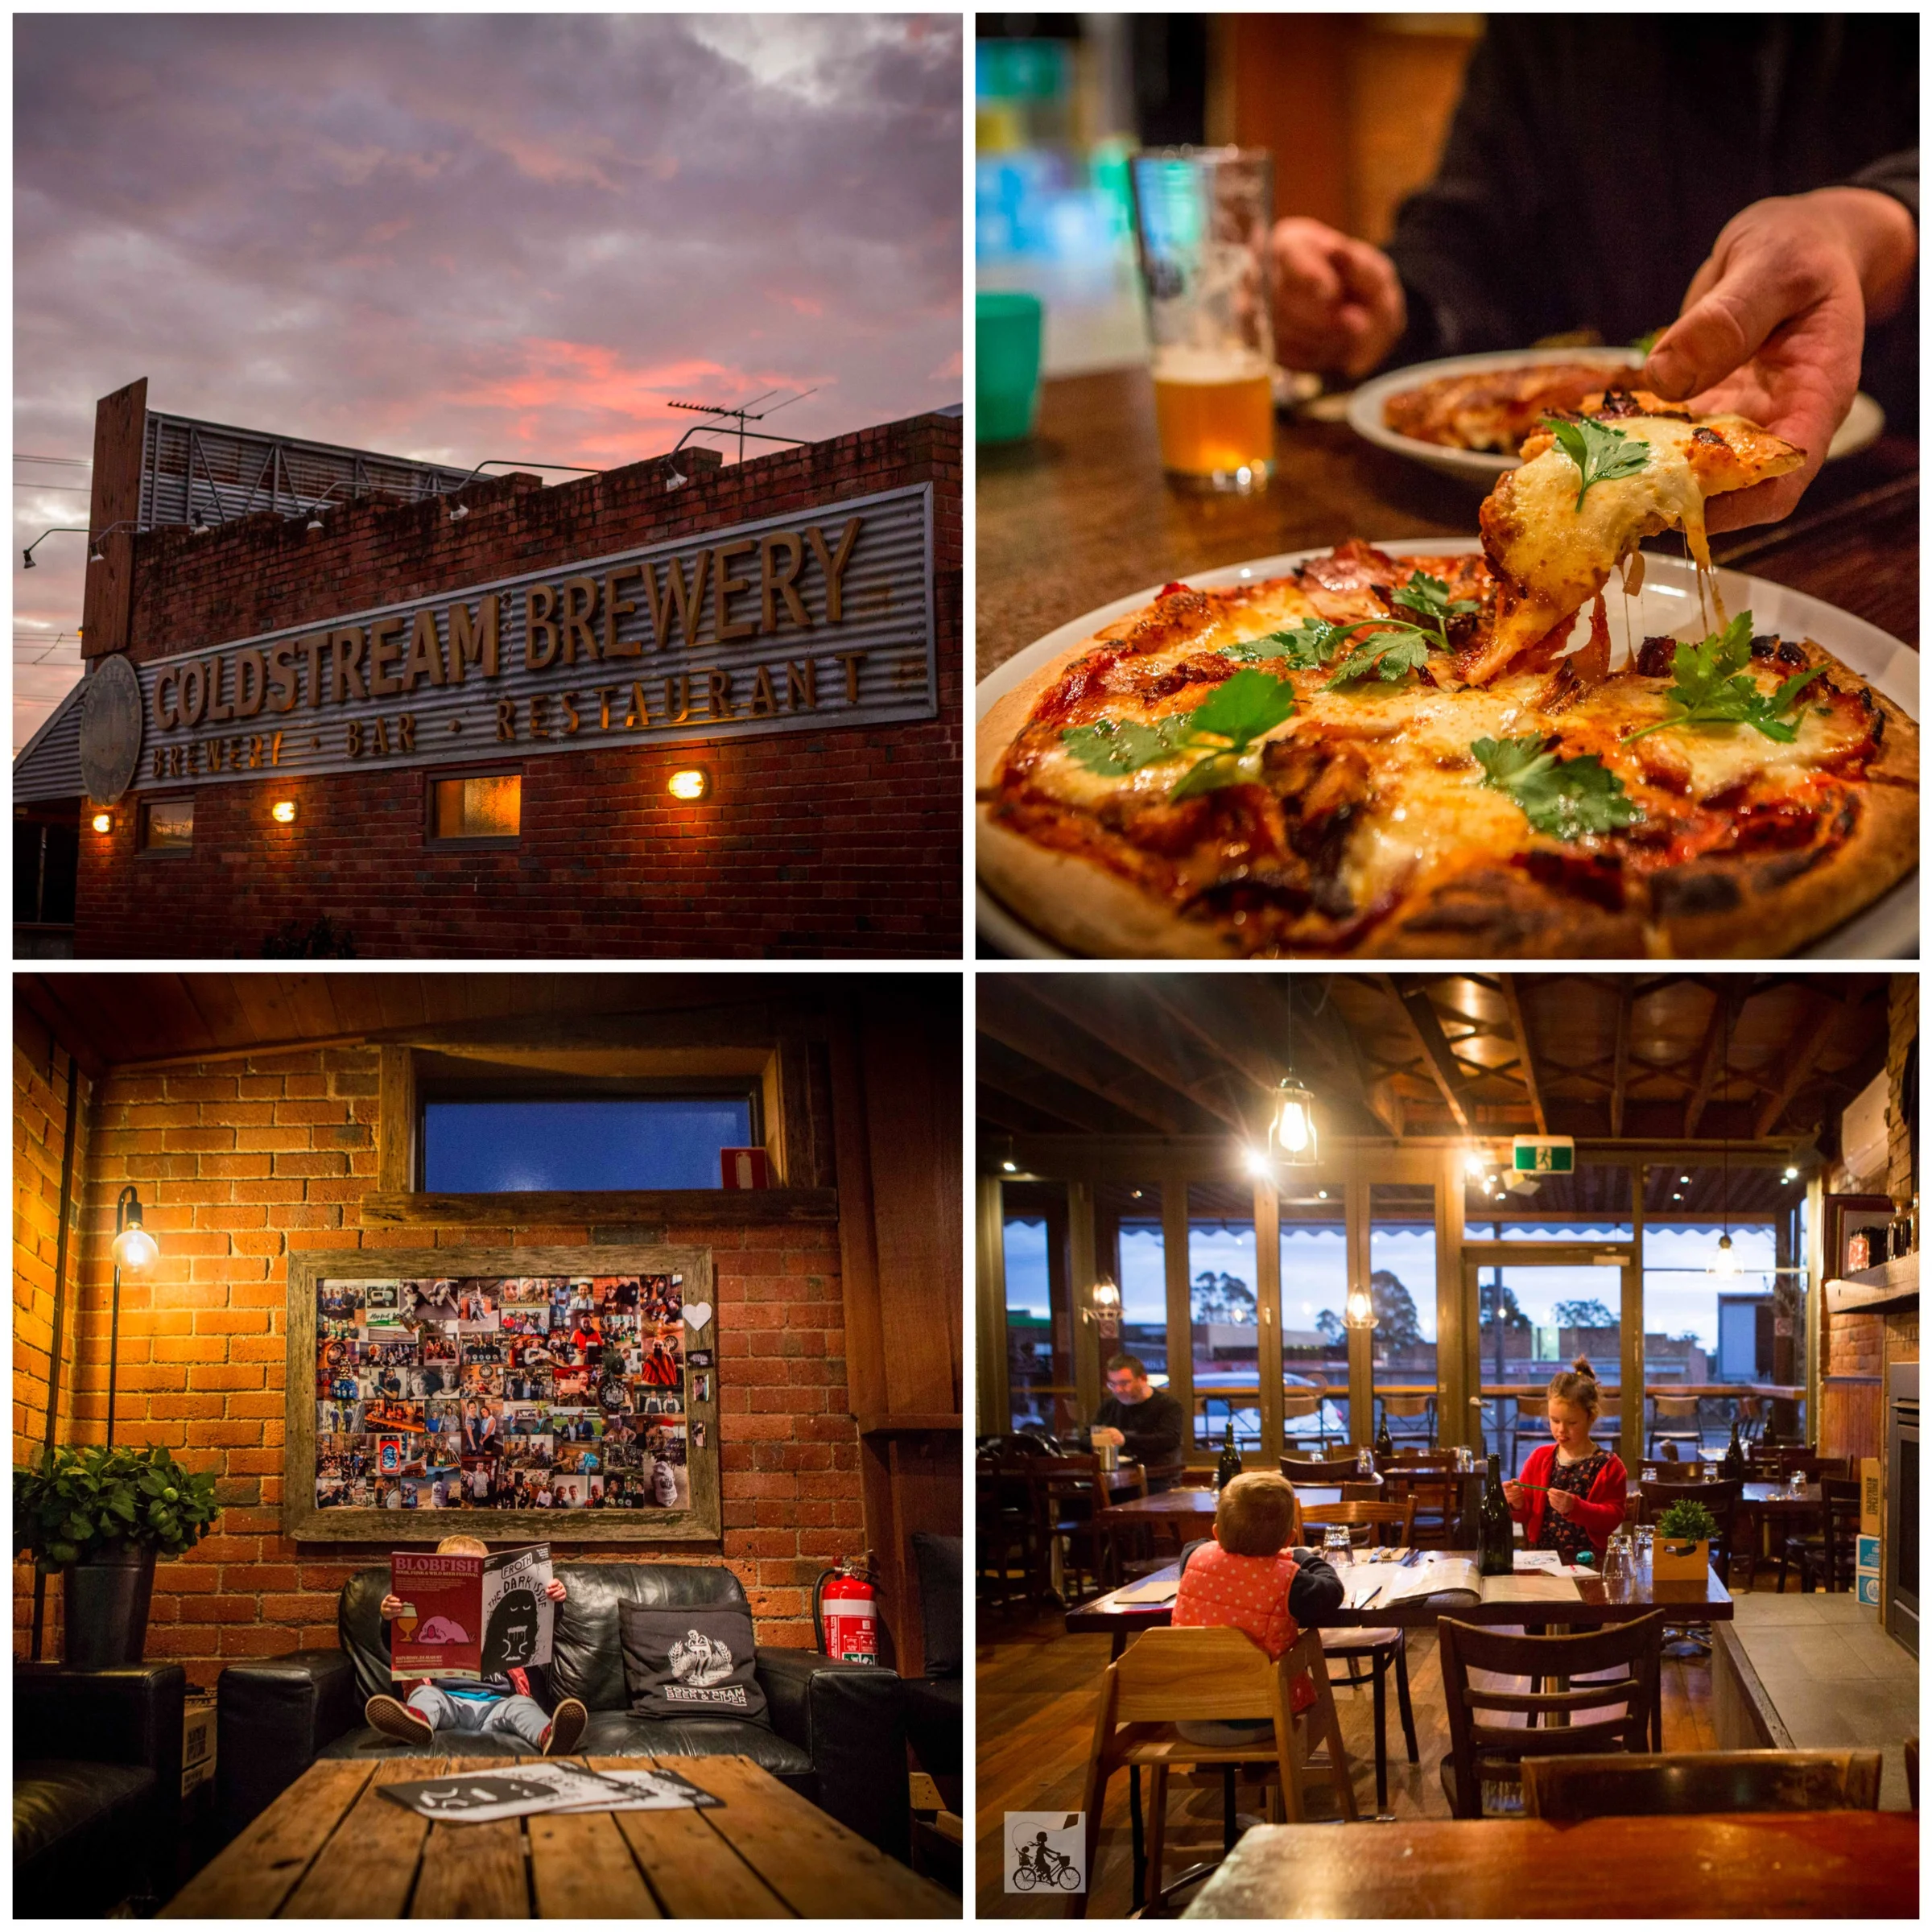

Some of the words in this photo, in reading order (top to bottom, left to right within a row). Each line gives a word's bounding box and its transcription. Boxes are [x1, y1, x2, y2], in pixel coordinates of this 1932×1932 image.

[152, 595, 499, 732] COLDSTREAM
[525, 516, 864, 671] BREWERY
[152, 731, 283, 778] BREWERY
[346, 712, 416, 758] BAR
[496, 650, 868, 741] RESTAURANT
[394, 1557, 480, 1573] BLOBFISH
[503, 1554, 532, 1577] FROTH
[488, 1590, 502, 1608] THE
[503, 1575, 533, 1594] DARK
[533, 1581, 547, 1608] ISSUE
[667, 1690, 698, 1700] BEER
[700, 1693, 709, 1701] &
[712, 1694, 747, 1704] CIDER
